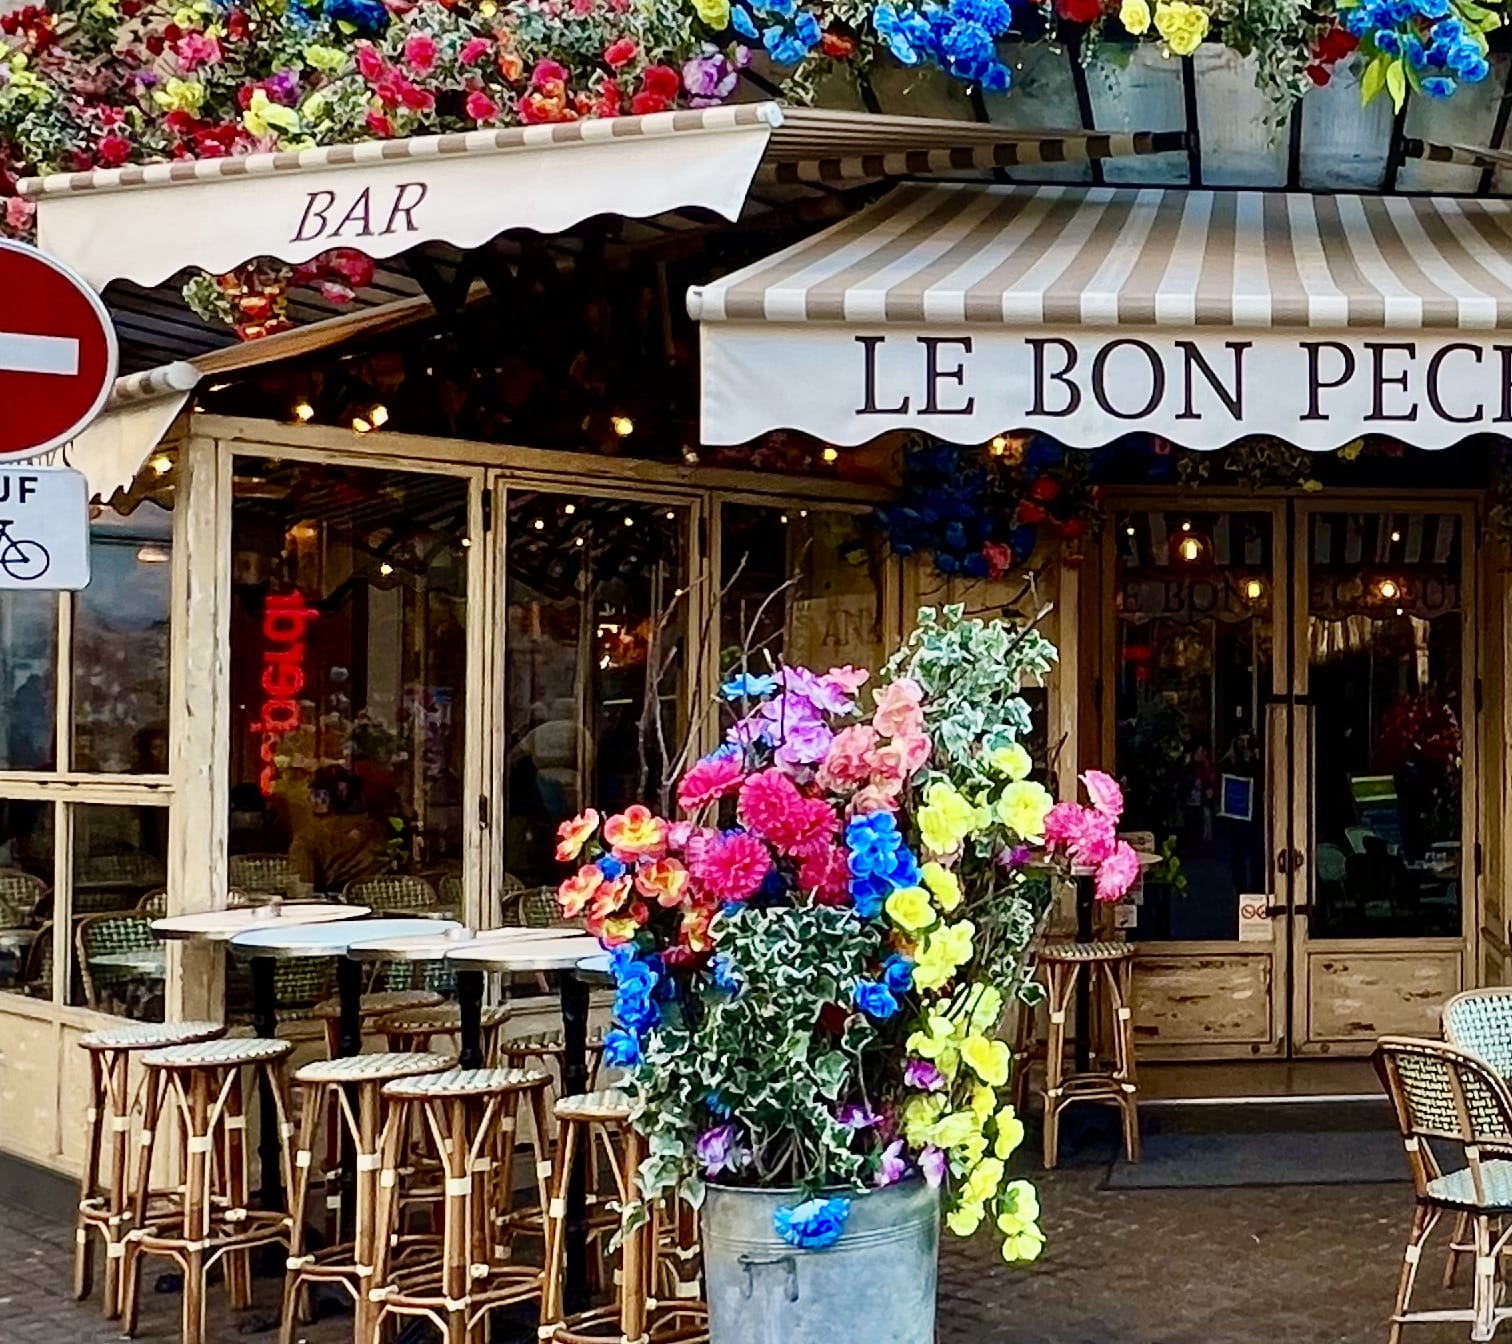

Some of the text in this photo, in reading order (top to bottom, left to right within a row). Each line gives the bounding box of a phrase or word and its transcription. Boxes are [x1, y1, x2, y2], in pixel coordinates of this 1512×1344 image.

[289, 182, 428, 244] BAR
[854, 336, 975, 416] LE
[1024, 337, 1253, 421] BON
